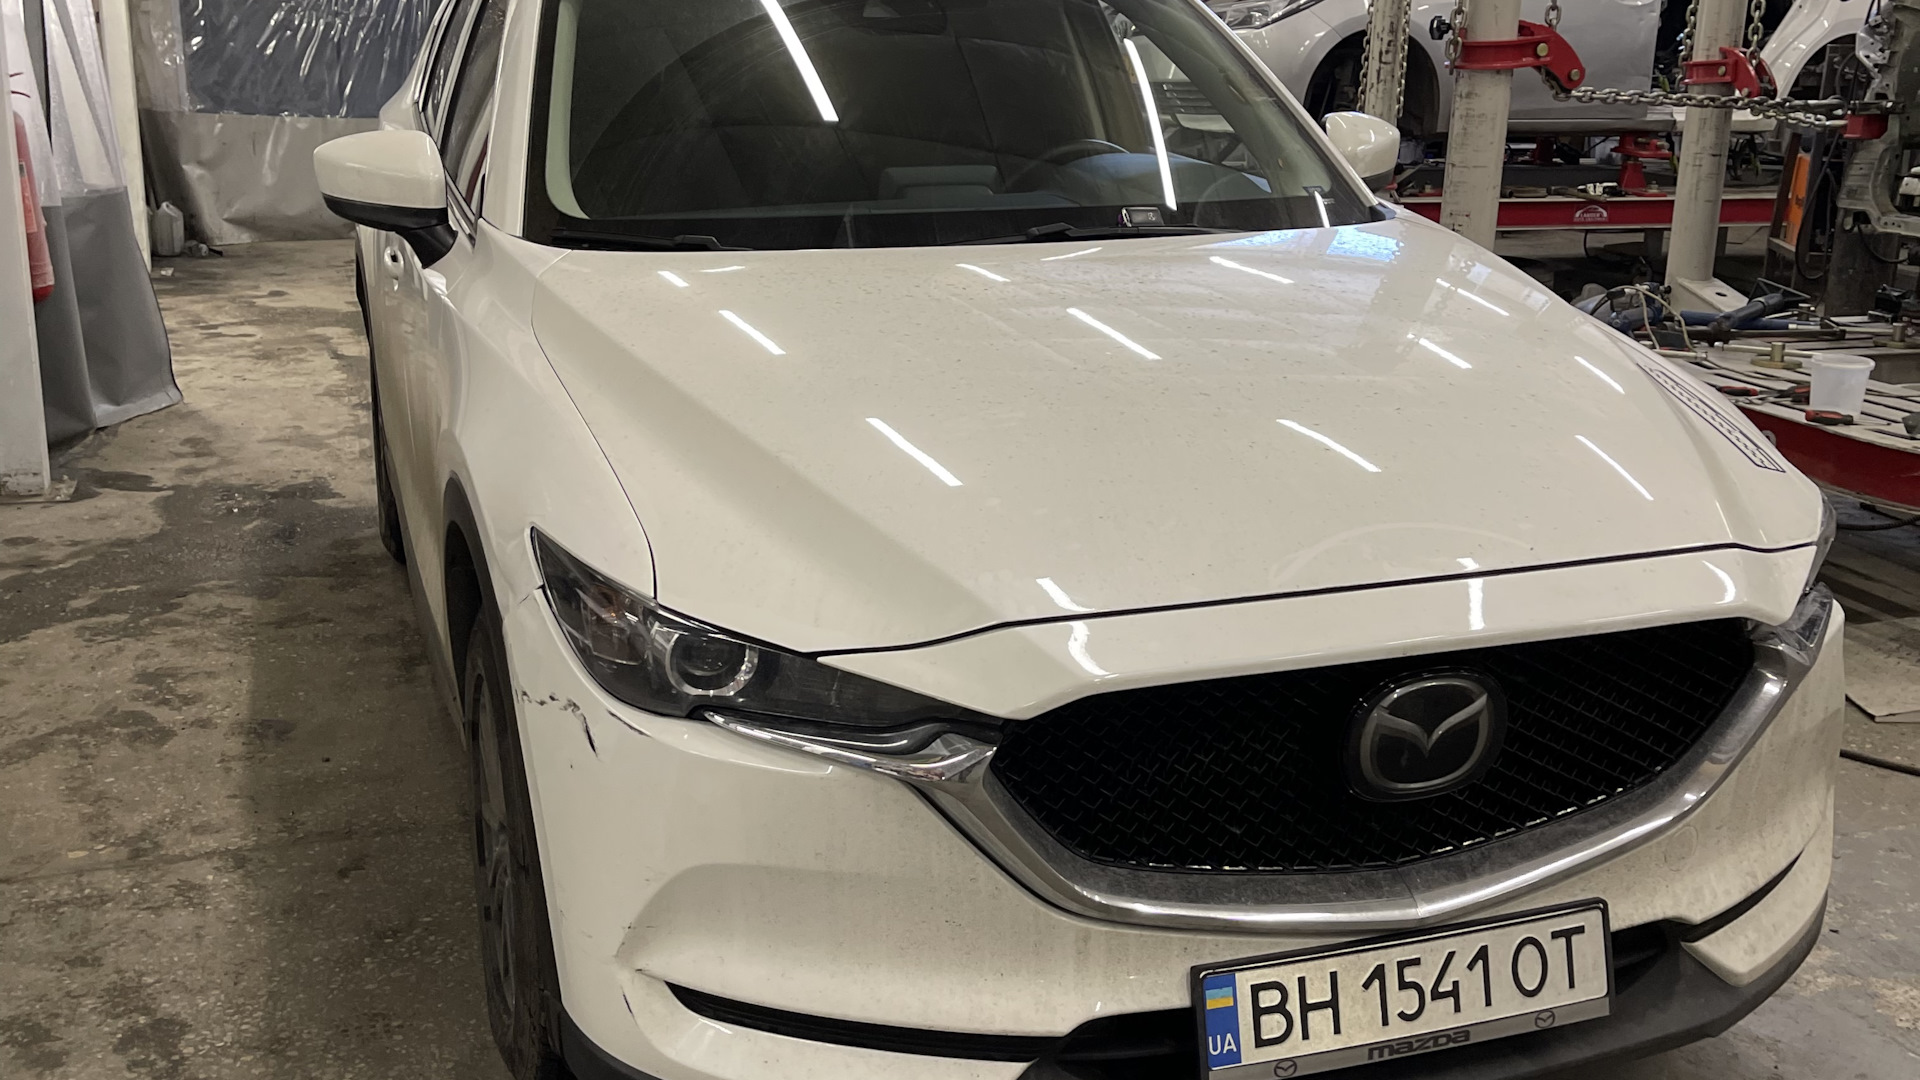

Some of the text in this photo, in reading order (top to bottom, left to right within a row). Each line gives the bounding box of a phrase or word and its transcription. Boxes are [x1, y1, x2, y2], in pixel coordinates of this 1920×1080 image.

[1250, 925, 1586, 1048] BH 1541 OT
[1208, 1033, 1237, 1055] UA
[1368, 1029, 1470, 1060] mazda
